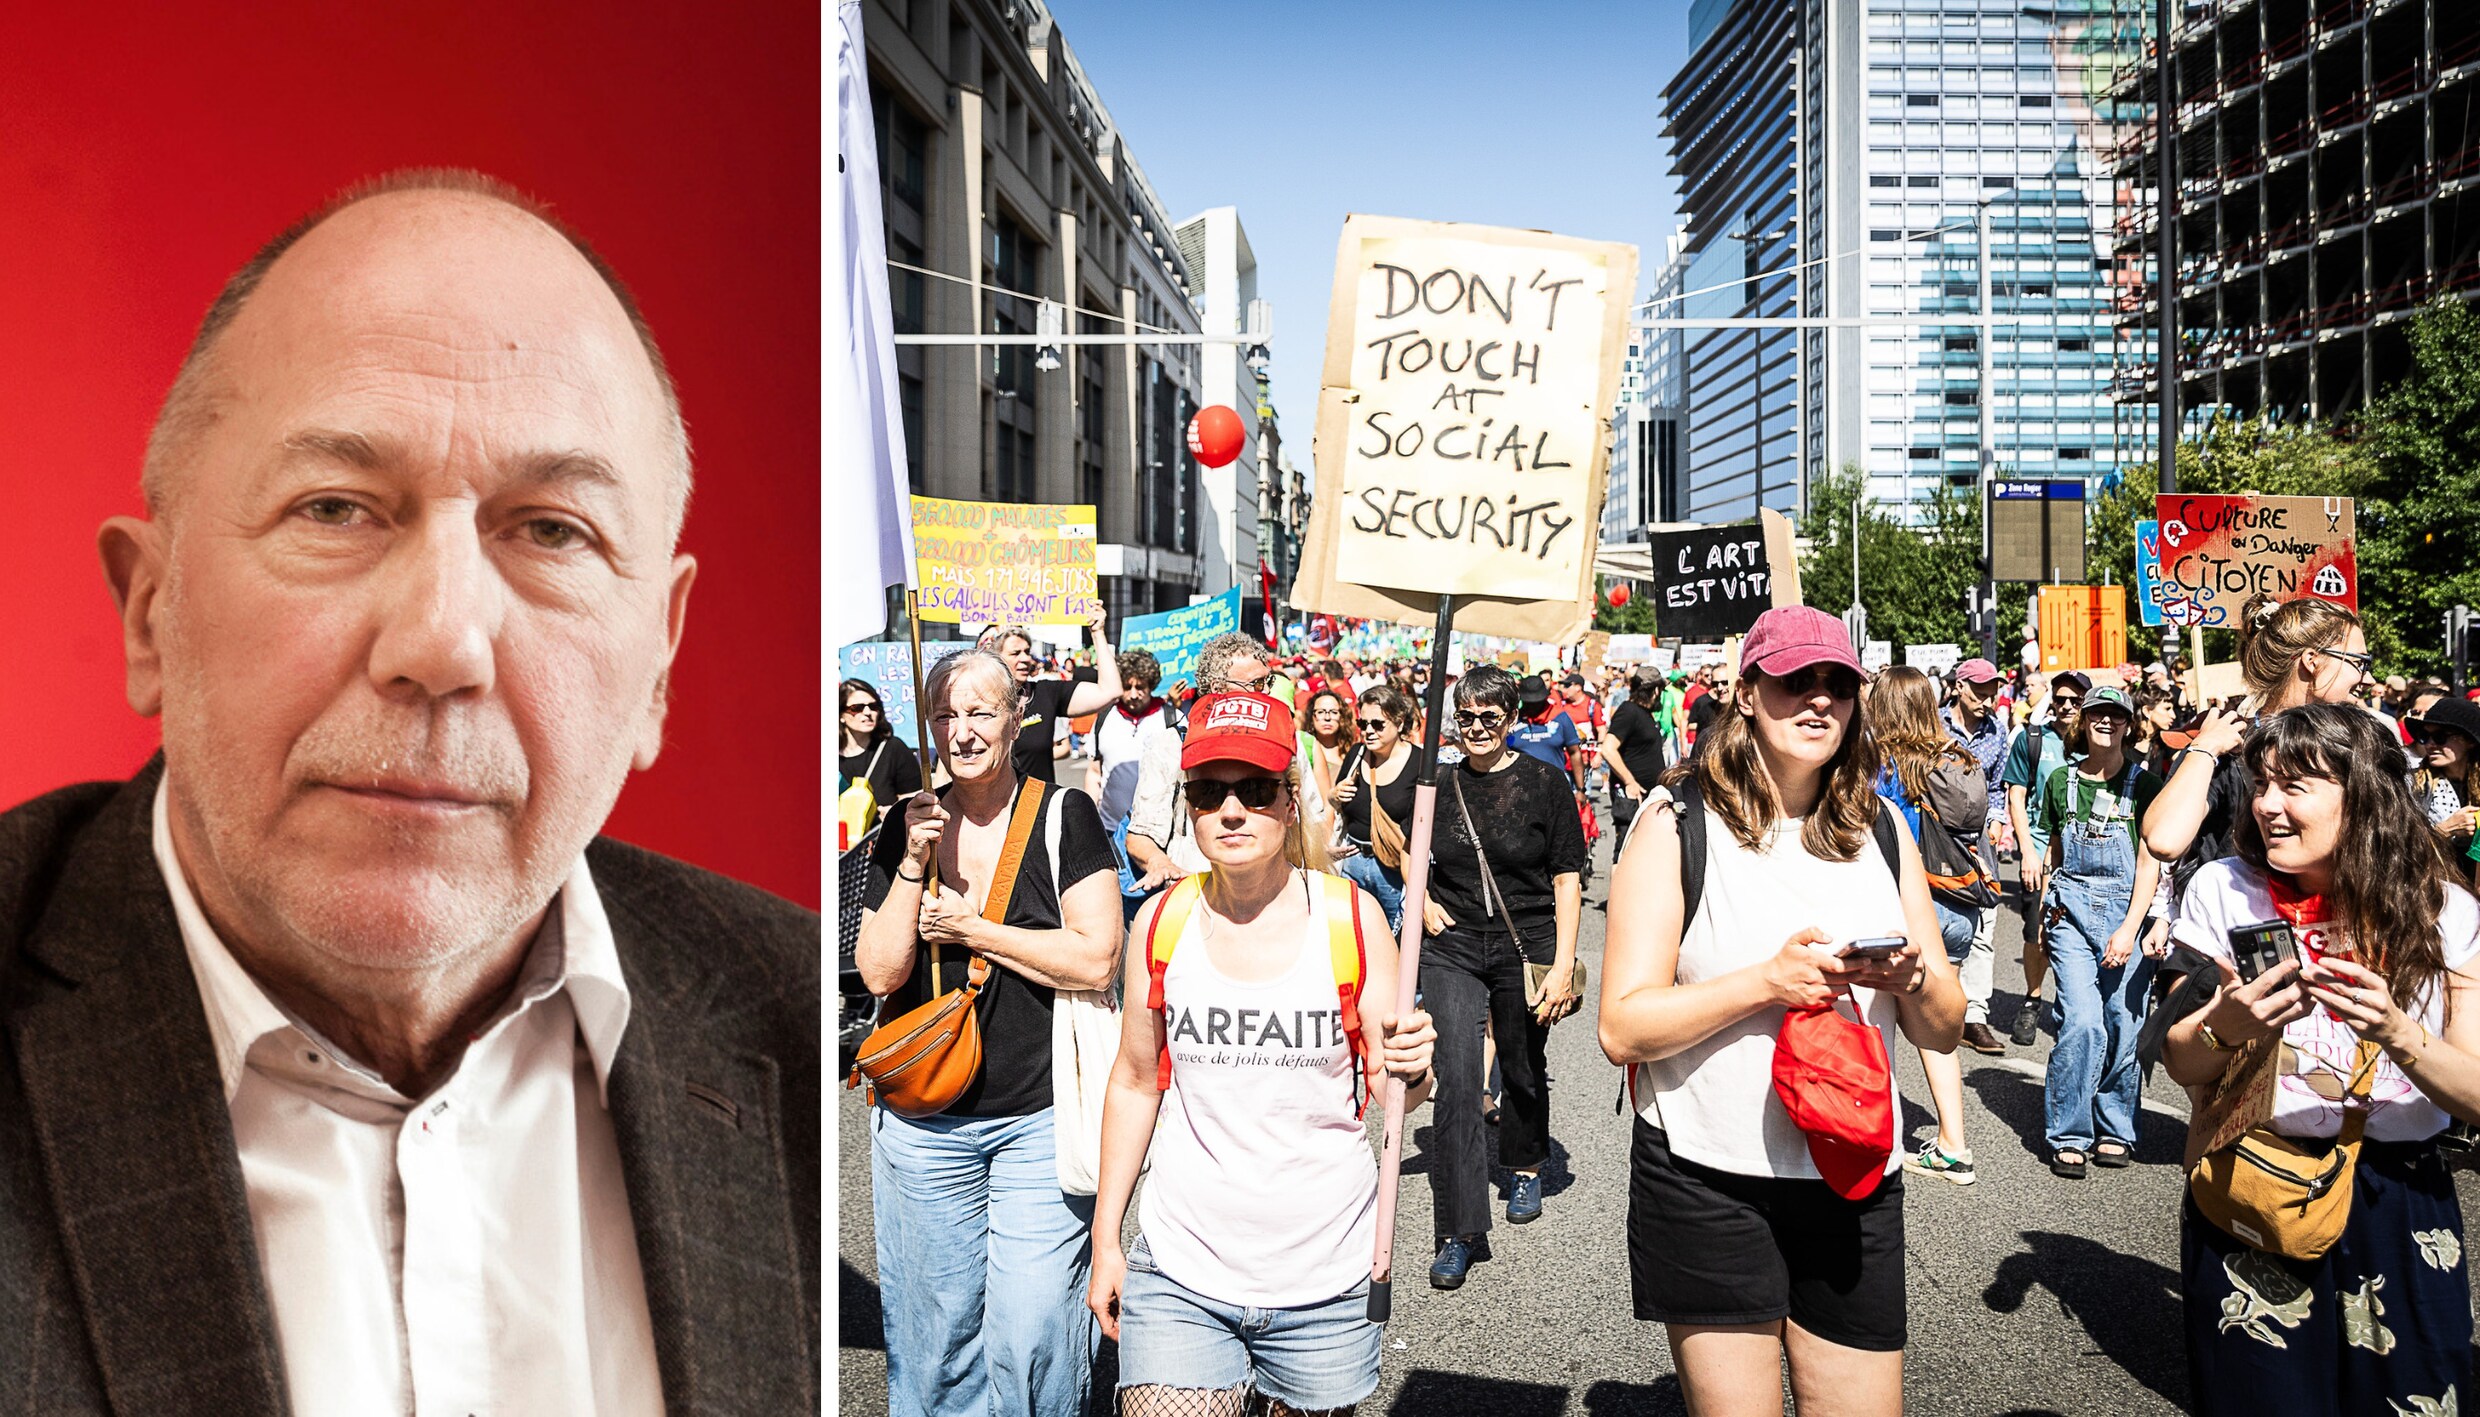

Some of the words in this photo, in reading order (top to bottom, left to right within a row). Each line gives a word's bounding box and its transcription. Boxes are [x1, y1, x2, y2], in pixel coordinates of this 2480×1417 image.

[1373, 262, 1584, 331] DON'T
[1368, 329, 1541, 384] TOUCH
[1432, 383, 1504, 414] AT
[991, 505, 1068, 530] MALADES
[989, 533, 1096, 568] CHÔMEURS
[1706, 541, 1760, 569] ART
[1055, 567, 1098, 595] JOBS
[1666, 579, 1716, 608] EST
[943, 586, 1010, 612] CALCULS
[1013, 593, 1058, 614] SONT
[961, 610, 998, 624] BONS
[849, 646, 877, 667] ON
[878, 664, 911, 682] LES
[1214, 699, 1267, 719] FGTB
[1177, 1051, 1206, 1063] avec
[1211, 1050, 1231, 1065] de
[1231, 1051, 1270, 1068] jolis
[1274, 1053, 1331, 1071] défauts
